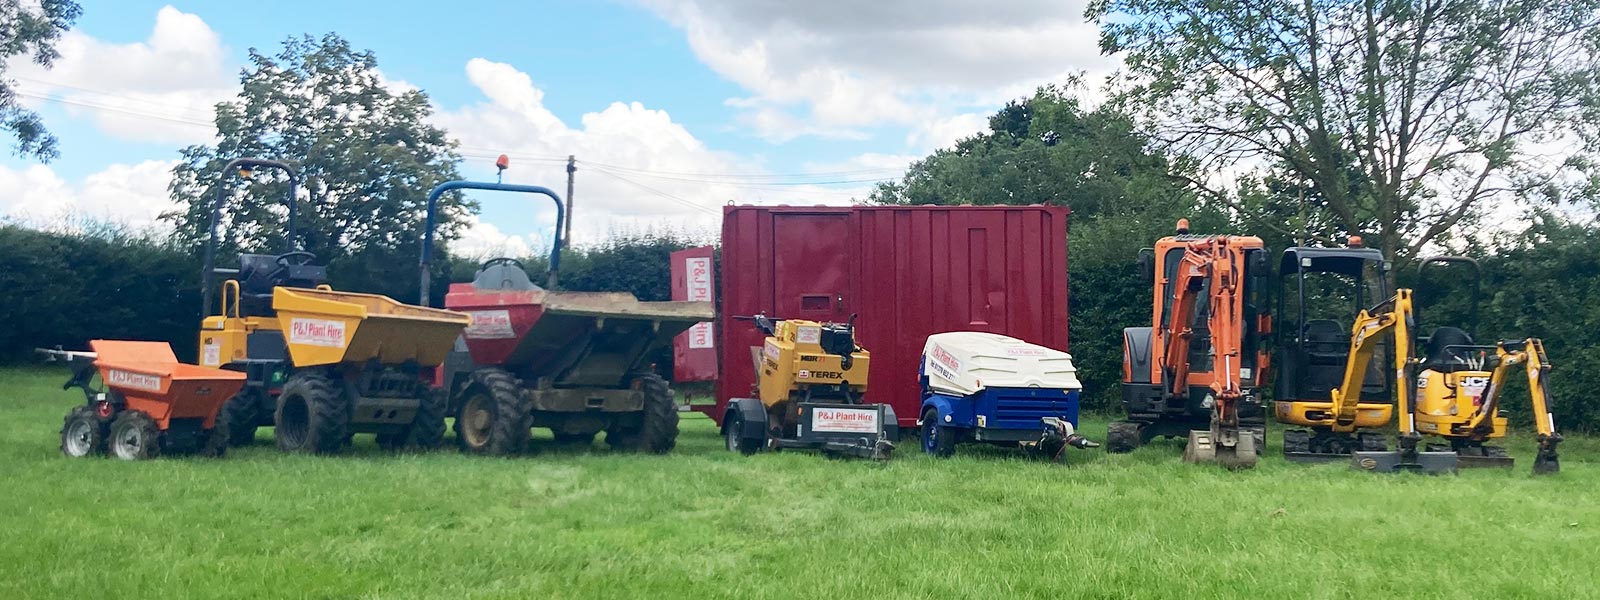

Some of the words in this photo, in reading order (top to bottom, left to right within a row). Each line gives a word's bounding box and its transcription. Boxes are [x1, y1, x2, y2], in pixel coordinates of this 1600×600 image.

[693, 260, 706, 283] P&J
[293, 321, 307, 336] P&J
[308, 323, 326, 337] Plant
[327, 325, 342, 339] Hire
[696, 322, 708, 345] Hire
[112, 370, 126, 382] P&J
[126, 372, 143, 385] Plant
[144, 376, 157, 387] Hire
[809, 371, 843, 379] TEREX
[818, 411, 834, 420] P&J
[836, 412, 856, 421] Plant
[857, 413, 873, 421] Hire
